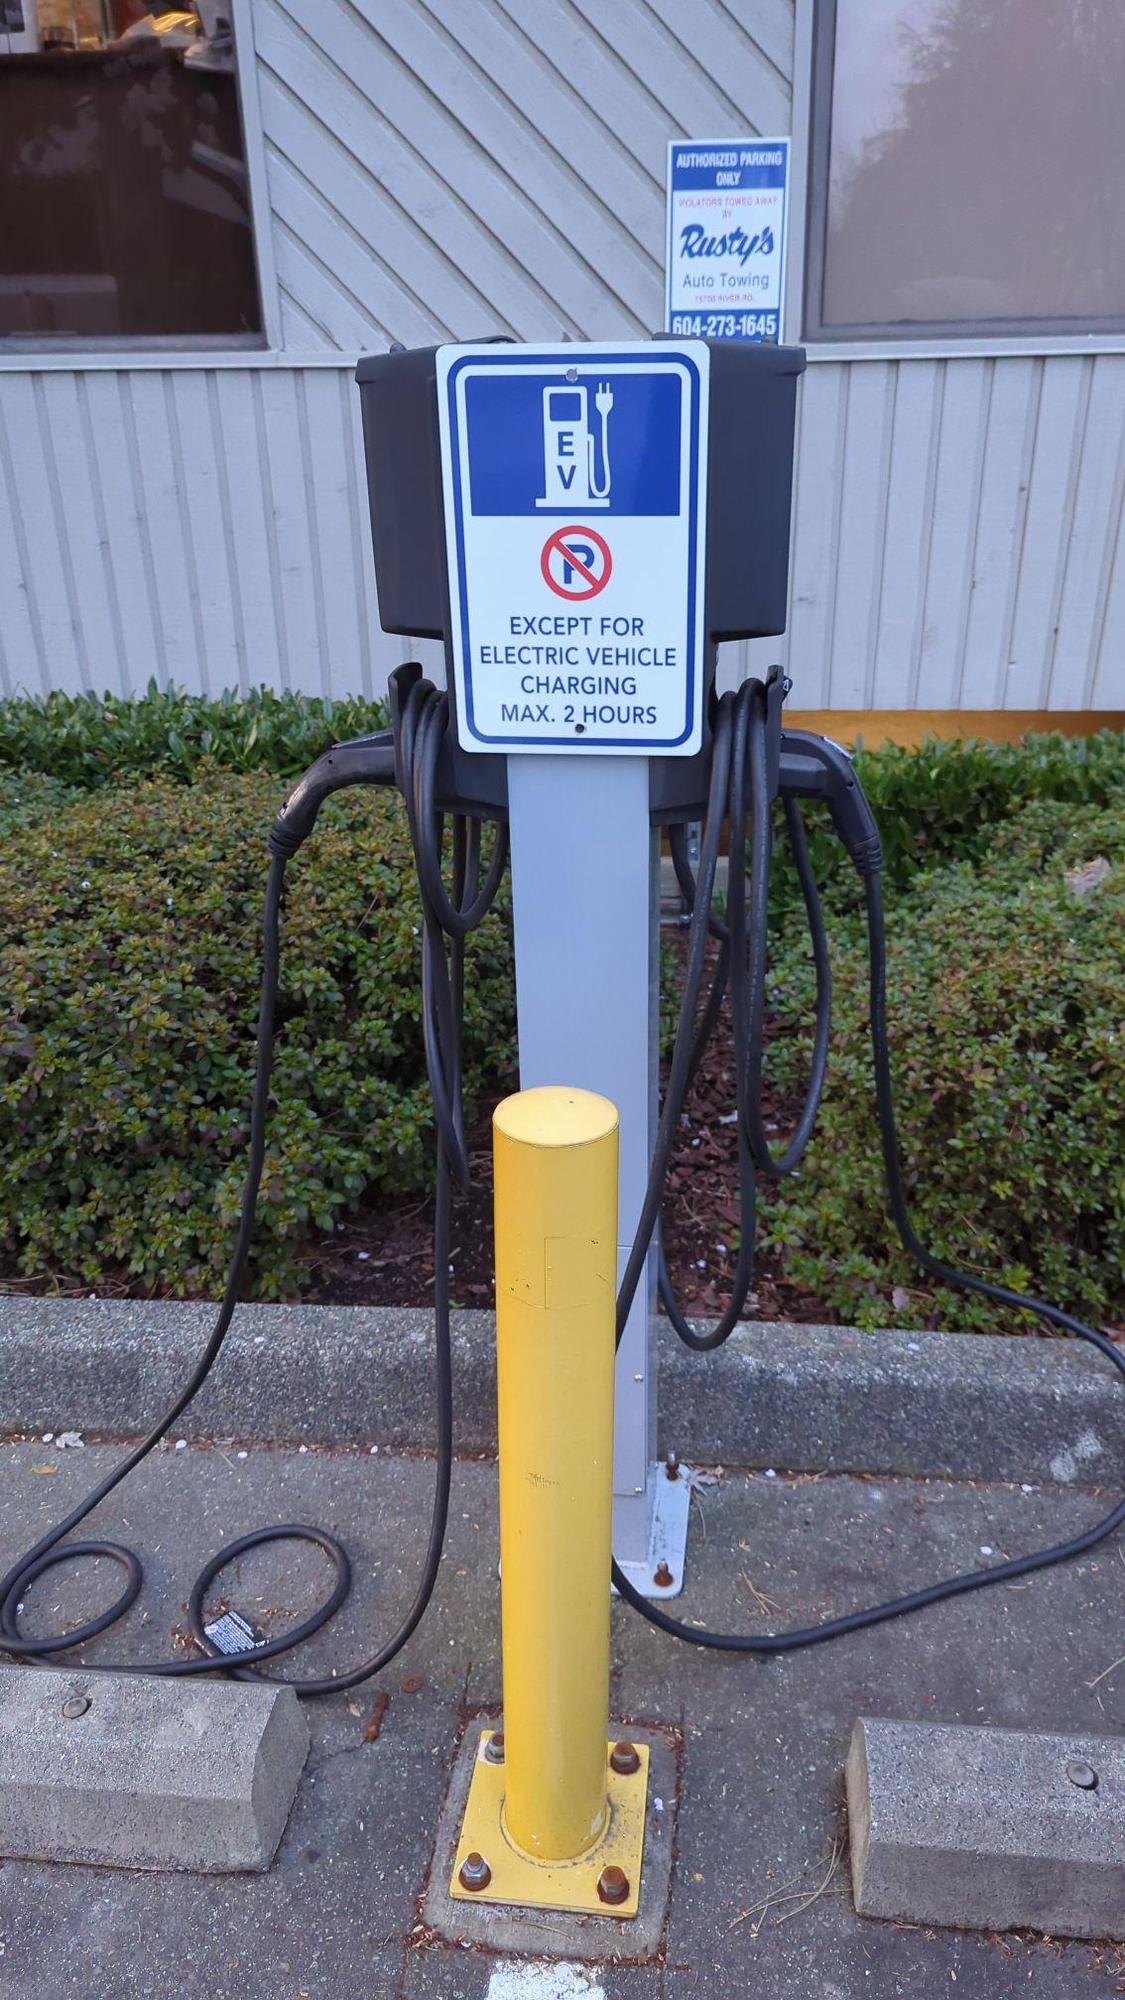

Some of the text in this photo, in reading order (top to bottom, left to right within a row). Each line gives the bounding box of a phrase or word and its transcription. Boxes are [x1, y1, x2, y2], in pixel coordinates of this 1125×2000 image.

[676, 151, 783, 168] AUTHORIZED PARKING
[716, 172, 741, 186] ONLY
[679, 196, 778, 207] VIOLATORS TOWED AWAY
[680, 223, 774, 266] Rusty's
[683, 272, 770, 288] Auto Towing
[718, 294, 741, 302] RIVER
[672, 315, 776, 336] 604-273-1645
[510, 617, 644, 636] EXCEPT FOR
[480, 646, 677, 666] ELECTRIC VEHICLE
[520, 676, 637, 695] CHARGING
[501, 704, 657, 724] MAX. 2 HOURS
